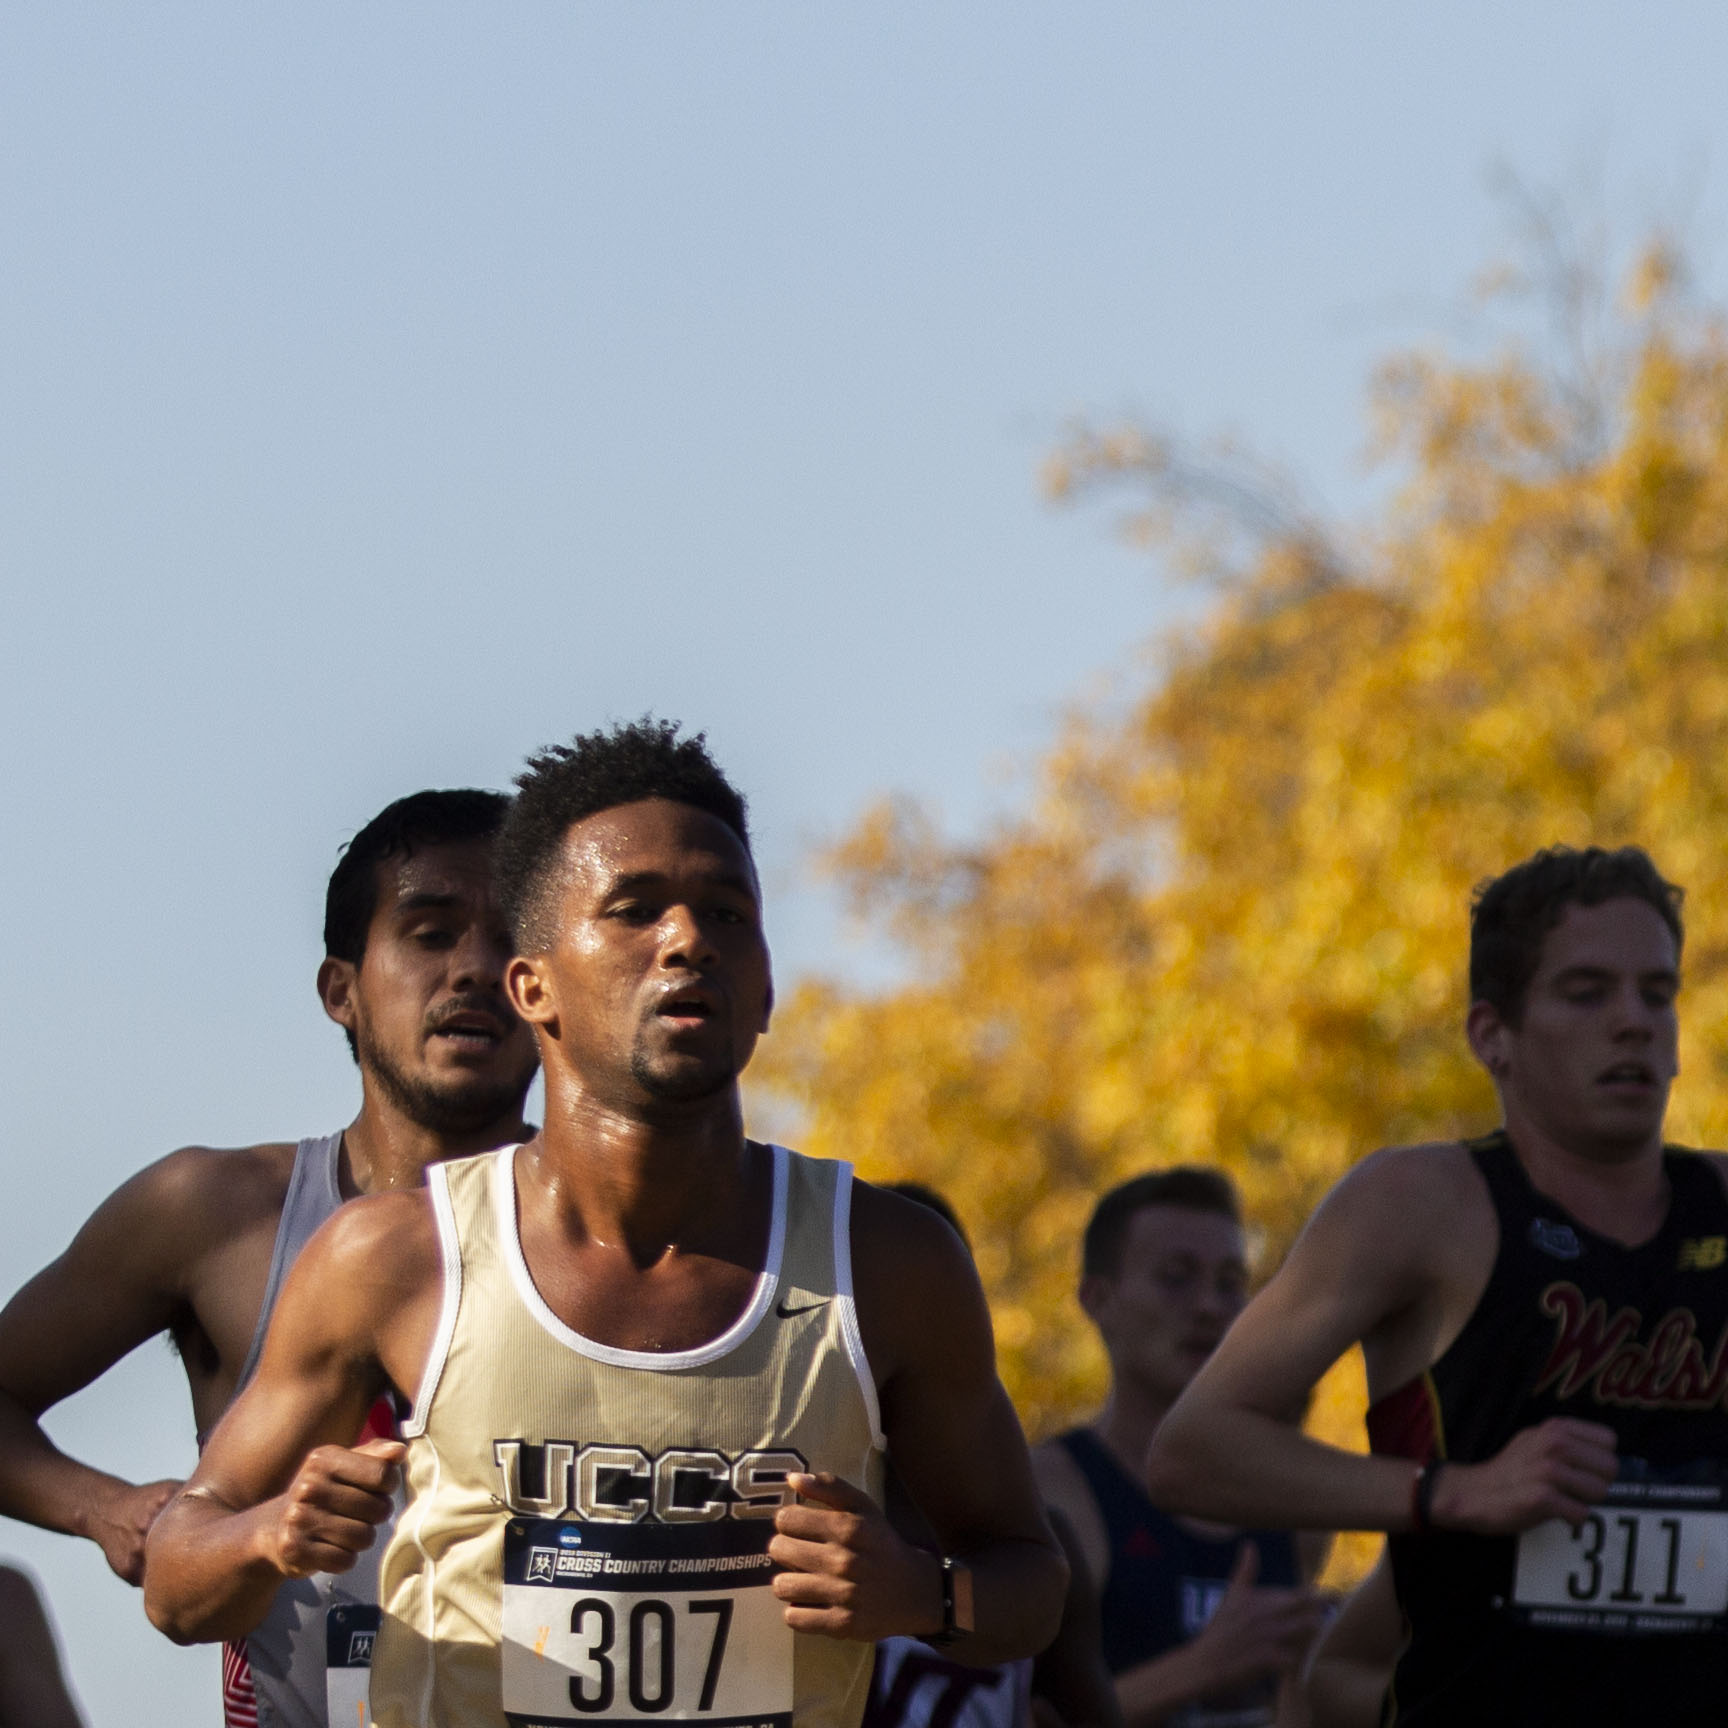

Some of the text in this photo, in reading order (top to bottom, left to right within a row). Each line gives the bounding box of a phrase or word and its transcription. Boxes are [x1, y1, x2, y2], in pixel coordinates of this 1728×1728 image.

[494, 1438, 809, 1523] UCCS
[557, 1553, 772, 1574] CROSS COUNTRY CHAMPIONSHIPS
[1568, 1511, 1686, 1605] 311
[569, 1597, 734, 1713] 307
